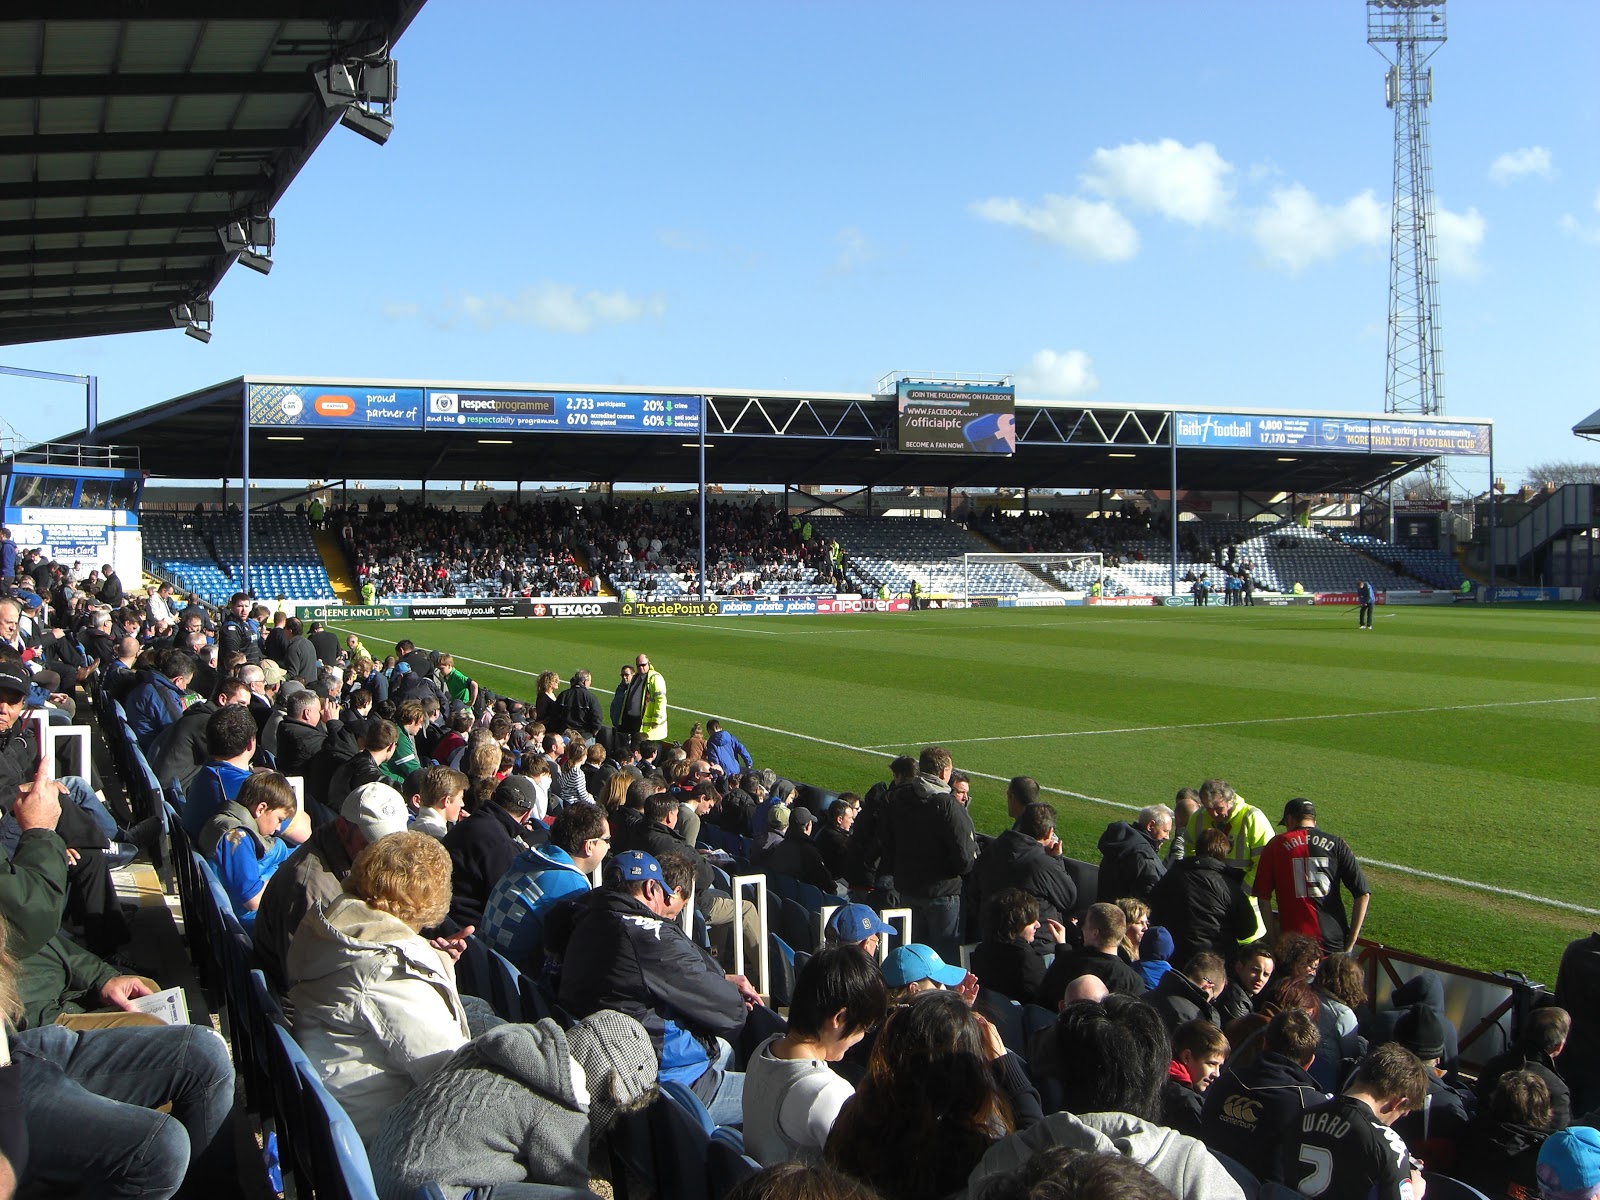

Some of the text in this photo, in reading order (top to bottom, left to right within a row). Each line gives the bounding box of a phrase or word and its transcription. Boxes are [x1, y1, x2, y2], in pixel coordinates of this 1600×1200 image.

[366, 393, 396, 406] proud
[566, 398, 594, 410] 2,733
[642, 400, 664, 412] 20%
[365, 406, 418, 422] partner of
[566, 414, 588, 425] 670
[517, 418, 559, 426] programme
[642, 415, 664, 426] 60%
[906, 417, 962, 430] /officialpfc
[1259, 420, 1282, 430] 4,800
[1178, 420, 1251, 437] faith football
[1344, 424, 1382, 433] Portsmouth
[1382, 425, 1390, 434] FC
[1392, 426, 1417, 436] working
[1426, 427, 1437, 436] the
[1260, 432, 1285, 444] 17,170
[1371, 436, 1391, 445] THAN
[1394, 437, 1410, 446] JUST
[1412, 438, 1418, 447] A
[1419, 439, 1455, 448] FOOTBALL
[53, 546, 74, 556] James
[314, 607, 390, 617] GREENE KING IPA
[413, 606, 496, 617] www.ridgeway.co.uk
[636, 603, 705, 614] TradePoint
[722, 600, 751, 613] jobsite
[754, 600, 784, 613] jobsite
[786, 600, 816, 613] jobsite
[1283, 834, 1335, 852] HALFORD
[1292, 857, 1331, 898] 15
[1219, 1114, 1257, 1132] canterbury
[1303, 1112, 1351, 1139] WARD
